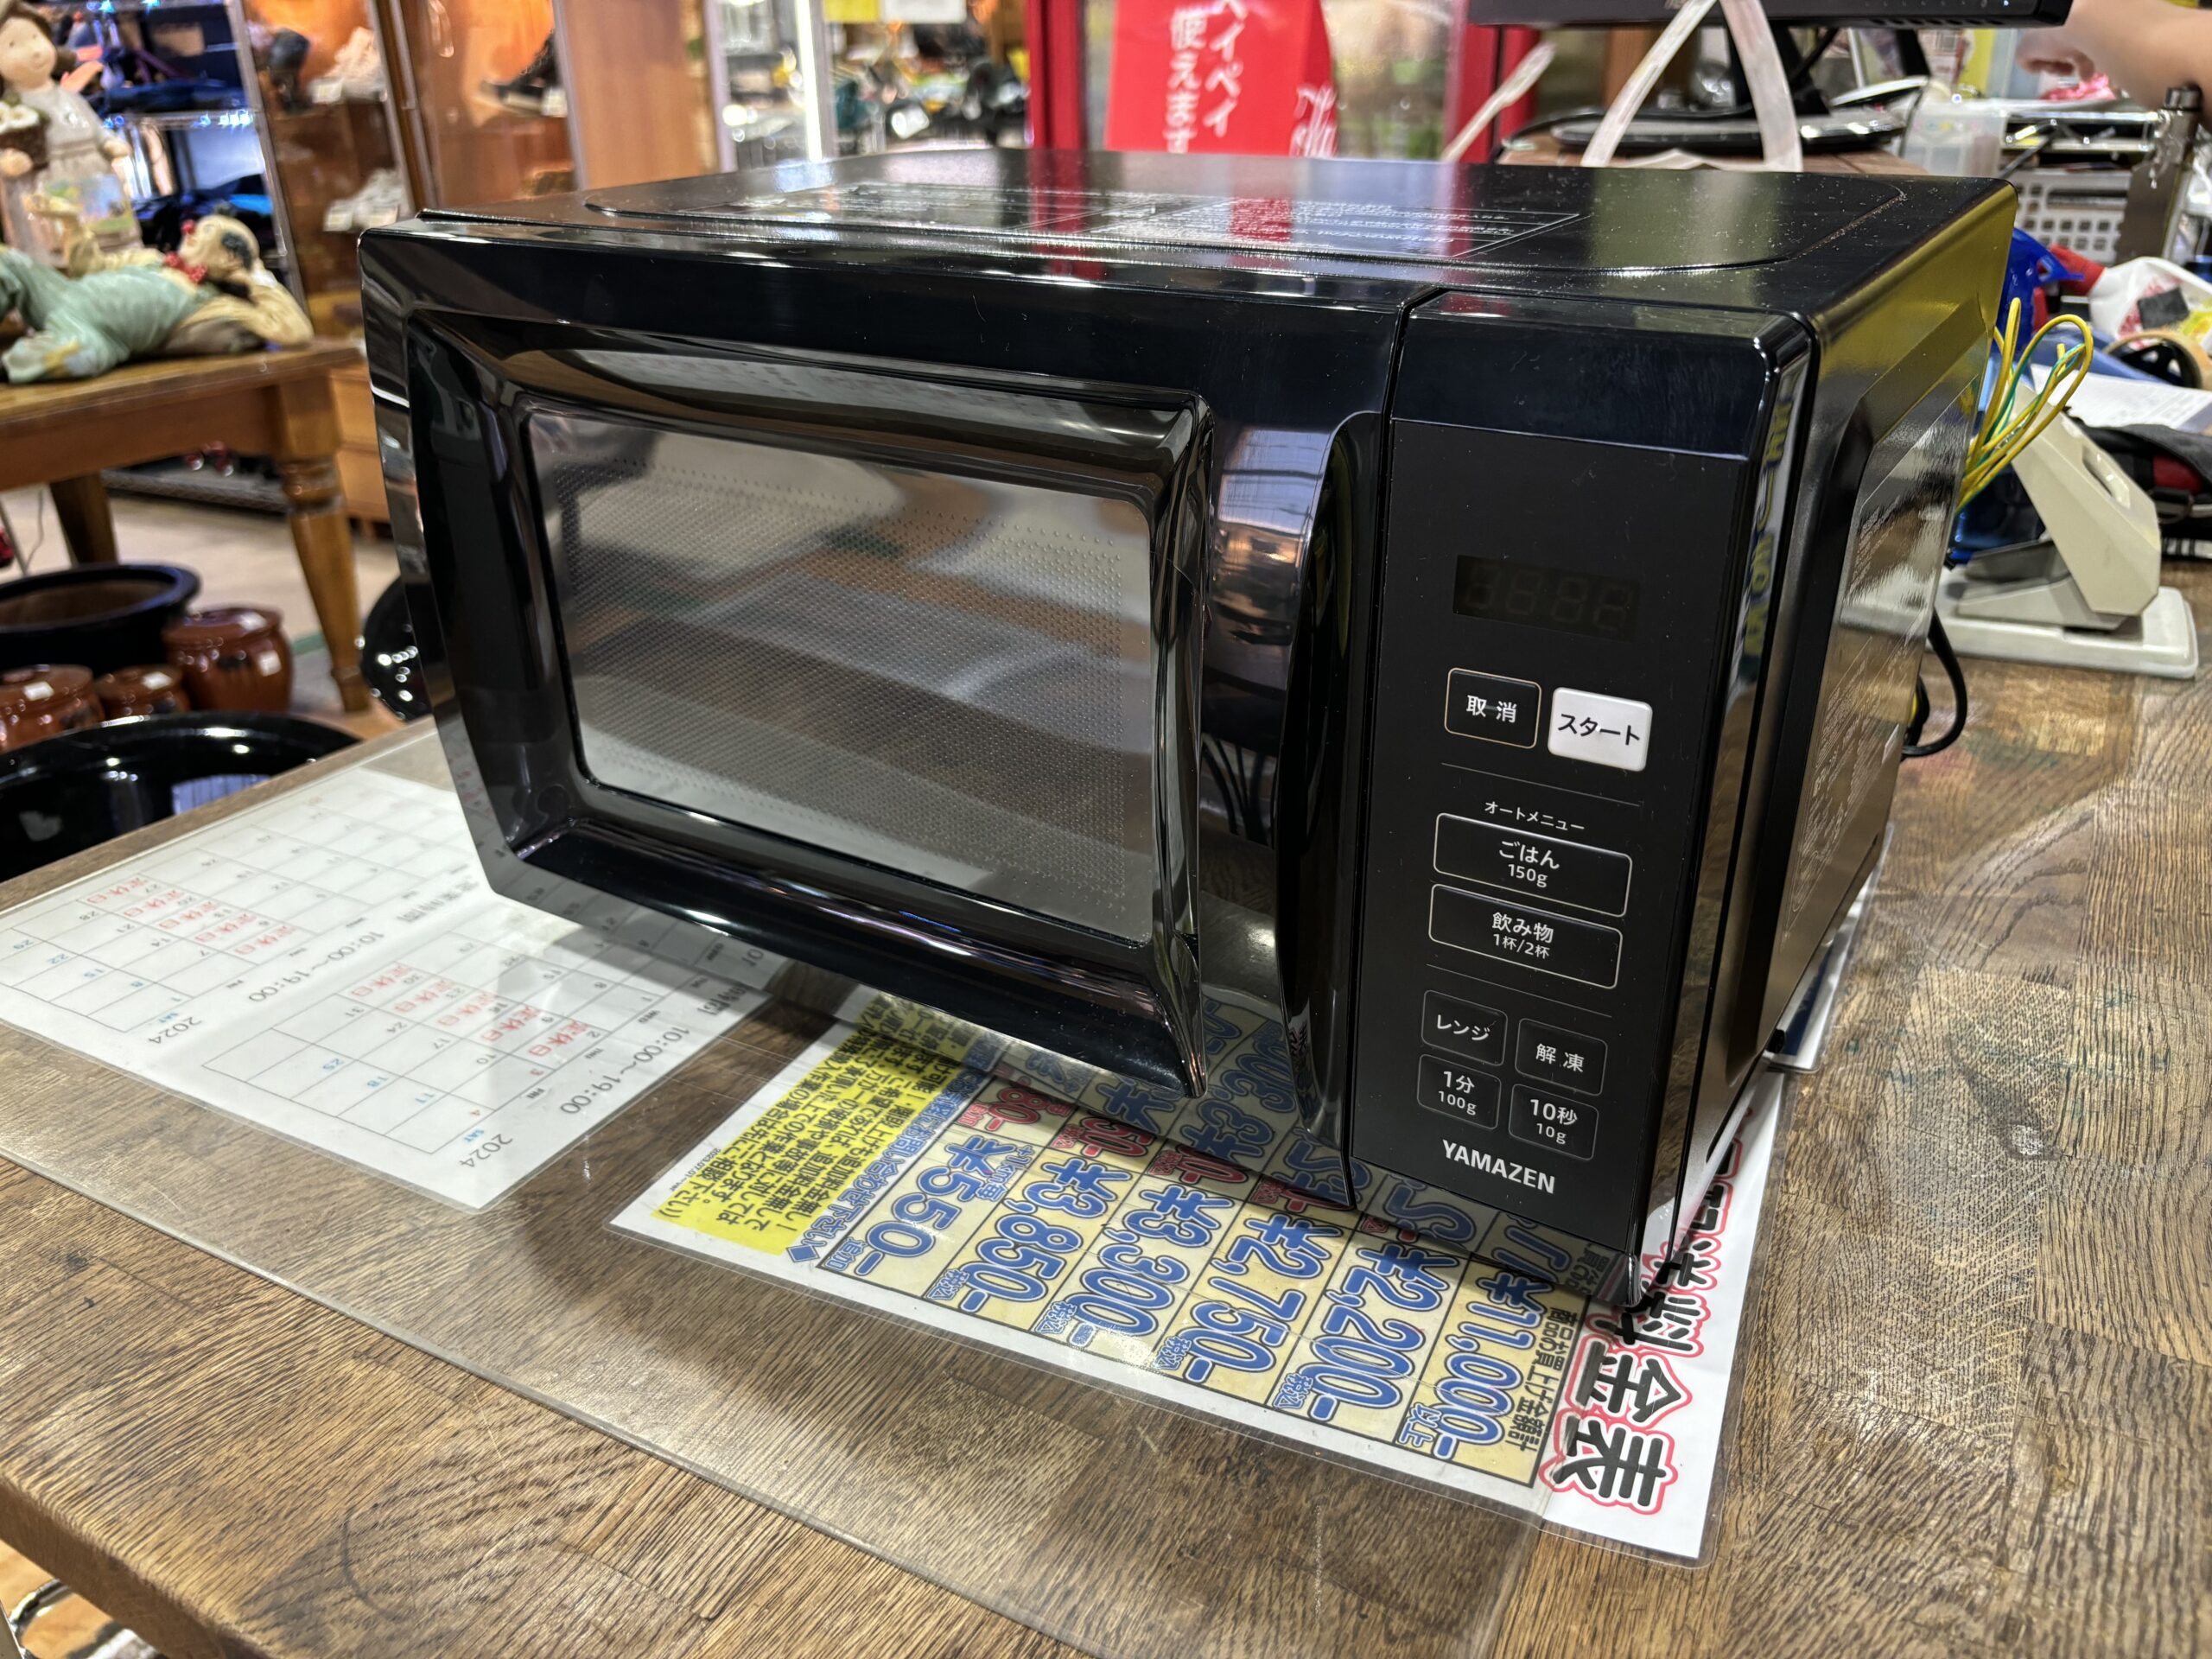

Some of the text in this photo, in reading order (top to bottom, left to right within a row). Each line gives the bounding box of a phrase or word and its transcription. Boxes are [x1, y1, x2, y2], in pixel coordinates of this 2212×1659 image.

[1466, 696, 1517, 723] 取消
[1557, 713, 1641, 747] スタート
[1484, 801, 1585, 831] オートメニュー
[1498, 841, 1560, 870] ごはん
[1508, 864, 1548, 888] 150g
[86, 877, 147, 904] 定休日
[123, 889, 184, 917] 定休日
[78, 911, 99, 920] 28
[116, 924, 135, 933] 21
[158, 900, 216, 929] 定休日
[194, 912, 256, 942] 定休日
[1491, 912, 1554, 943] 飲み物
[12, 939, 34, 950] 29
[149, 938, 170, 947] 14
[234, 925, 294, 955] 定休日
[1492, 933, 1550, 959] 1杯/2杯
[48, 953, 69, 963] 22
[83, 968, 104, 977] 15
[351, 964, 410, 996] 定休日
[394, 978, 454, 1013] 定休日
[437, 993, 496, 1026] 定休日
[488, 1001, 508, 1013] 16
[697, 982, 748, 1015] 時間
[158, 1012, 178, 1022] SAT
[344, 1007, 364, 1017] 31
[482, 1005, 541, 1041] 定休日
[148, 1016, 201, 1044] 2024
[385, 1021, 407, 1033] 24
[528, 1020, 589, 1056] 定休日
[1437, 1014, 1491, 1042] レンジ
[432, 1038, 450, 1048] 17
[321, 1058, 344, 1071] 25
[475, 1053, 496, 1065] 10
[1536, 1044, 1585, 1072] 解凍
[366, 1076, 388, 1087] 18
[525, 1087, 544, 1098] FRI
[1443, 1071, 1474, 1094] 1分
[414, 1092, 435, 1103] 11
[1438, 1090, 1478, 1116] 100g
[1529, 1098, 1578, 1126] 10秒
[463, 1128, 484, 1142] SAT
[1535, 1123, 1567, 1145] 10g
[459, 1133, 512, 1167] 2024
[1442, 1140, 1555, 1194] YAMAZEN
[824, 1237, 864, 1271] 追加
[928, 1268, 971, 1301] 税込
[1035, 1300, 1078, 1334] 税込
[1156, 1335, 1192, 1370] 税込
[1273, 1372, 1313, 1409] 税込
[1505, 1306, 1577, 1453] 商品お買上げ金額計
[1398, 1403, 1442, 1446] 以上
